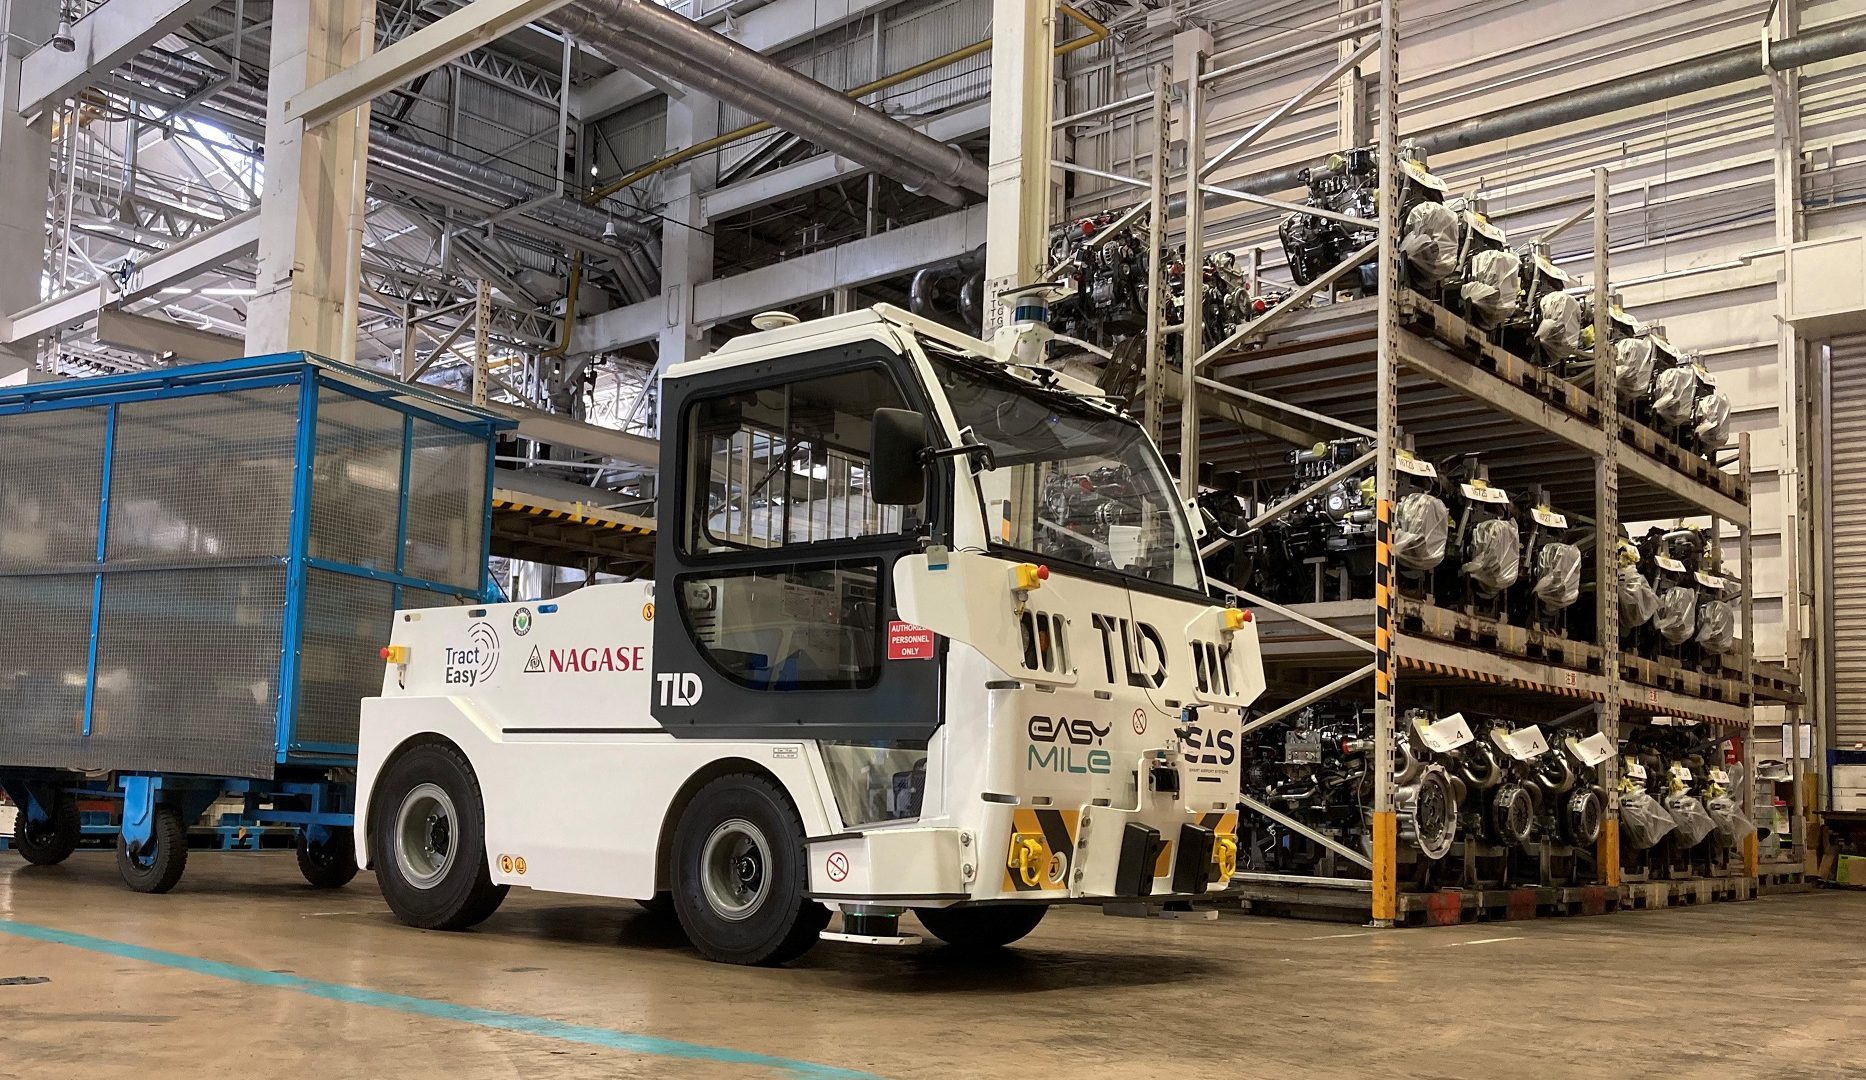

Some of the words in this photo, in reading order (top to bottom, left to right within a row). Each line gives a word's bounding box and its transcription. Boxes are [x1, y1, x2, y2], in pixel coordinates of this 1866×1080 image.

[891, 634, 930, 644] PERSONNEL
[445, 646, 480, 665] Tract
[549, 646, 645, 673] NAGASE
[901, 647, 919, 656] ONLY
[1091, 612, 1169, 690] TLD
[445, 666, 478, 687] Easy
[656, 672, 703, 707] TLD
[1456, 730, 1464, 739] 4
[1184, 726, 1235, 766] SAS
[1532, 740, 1539, 749] 4
[1600, 747, 1607, 755] 4
